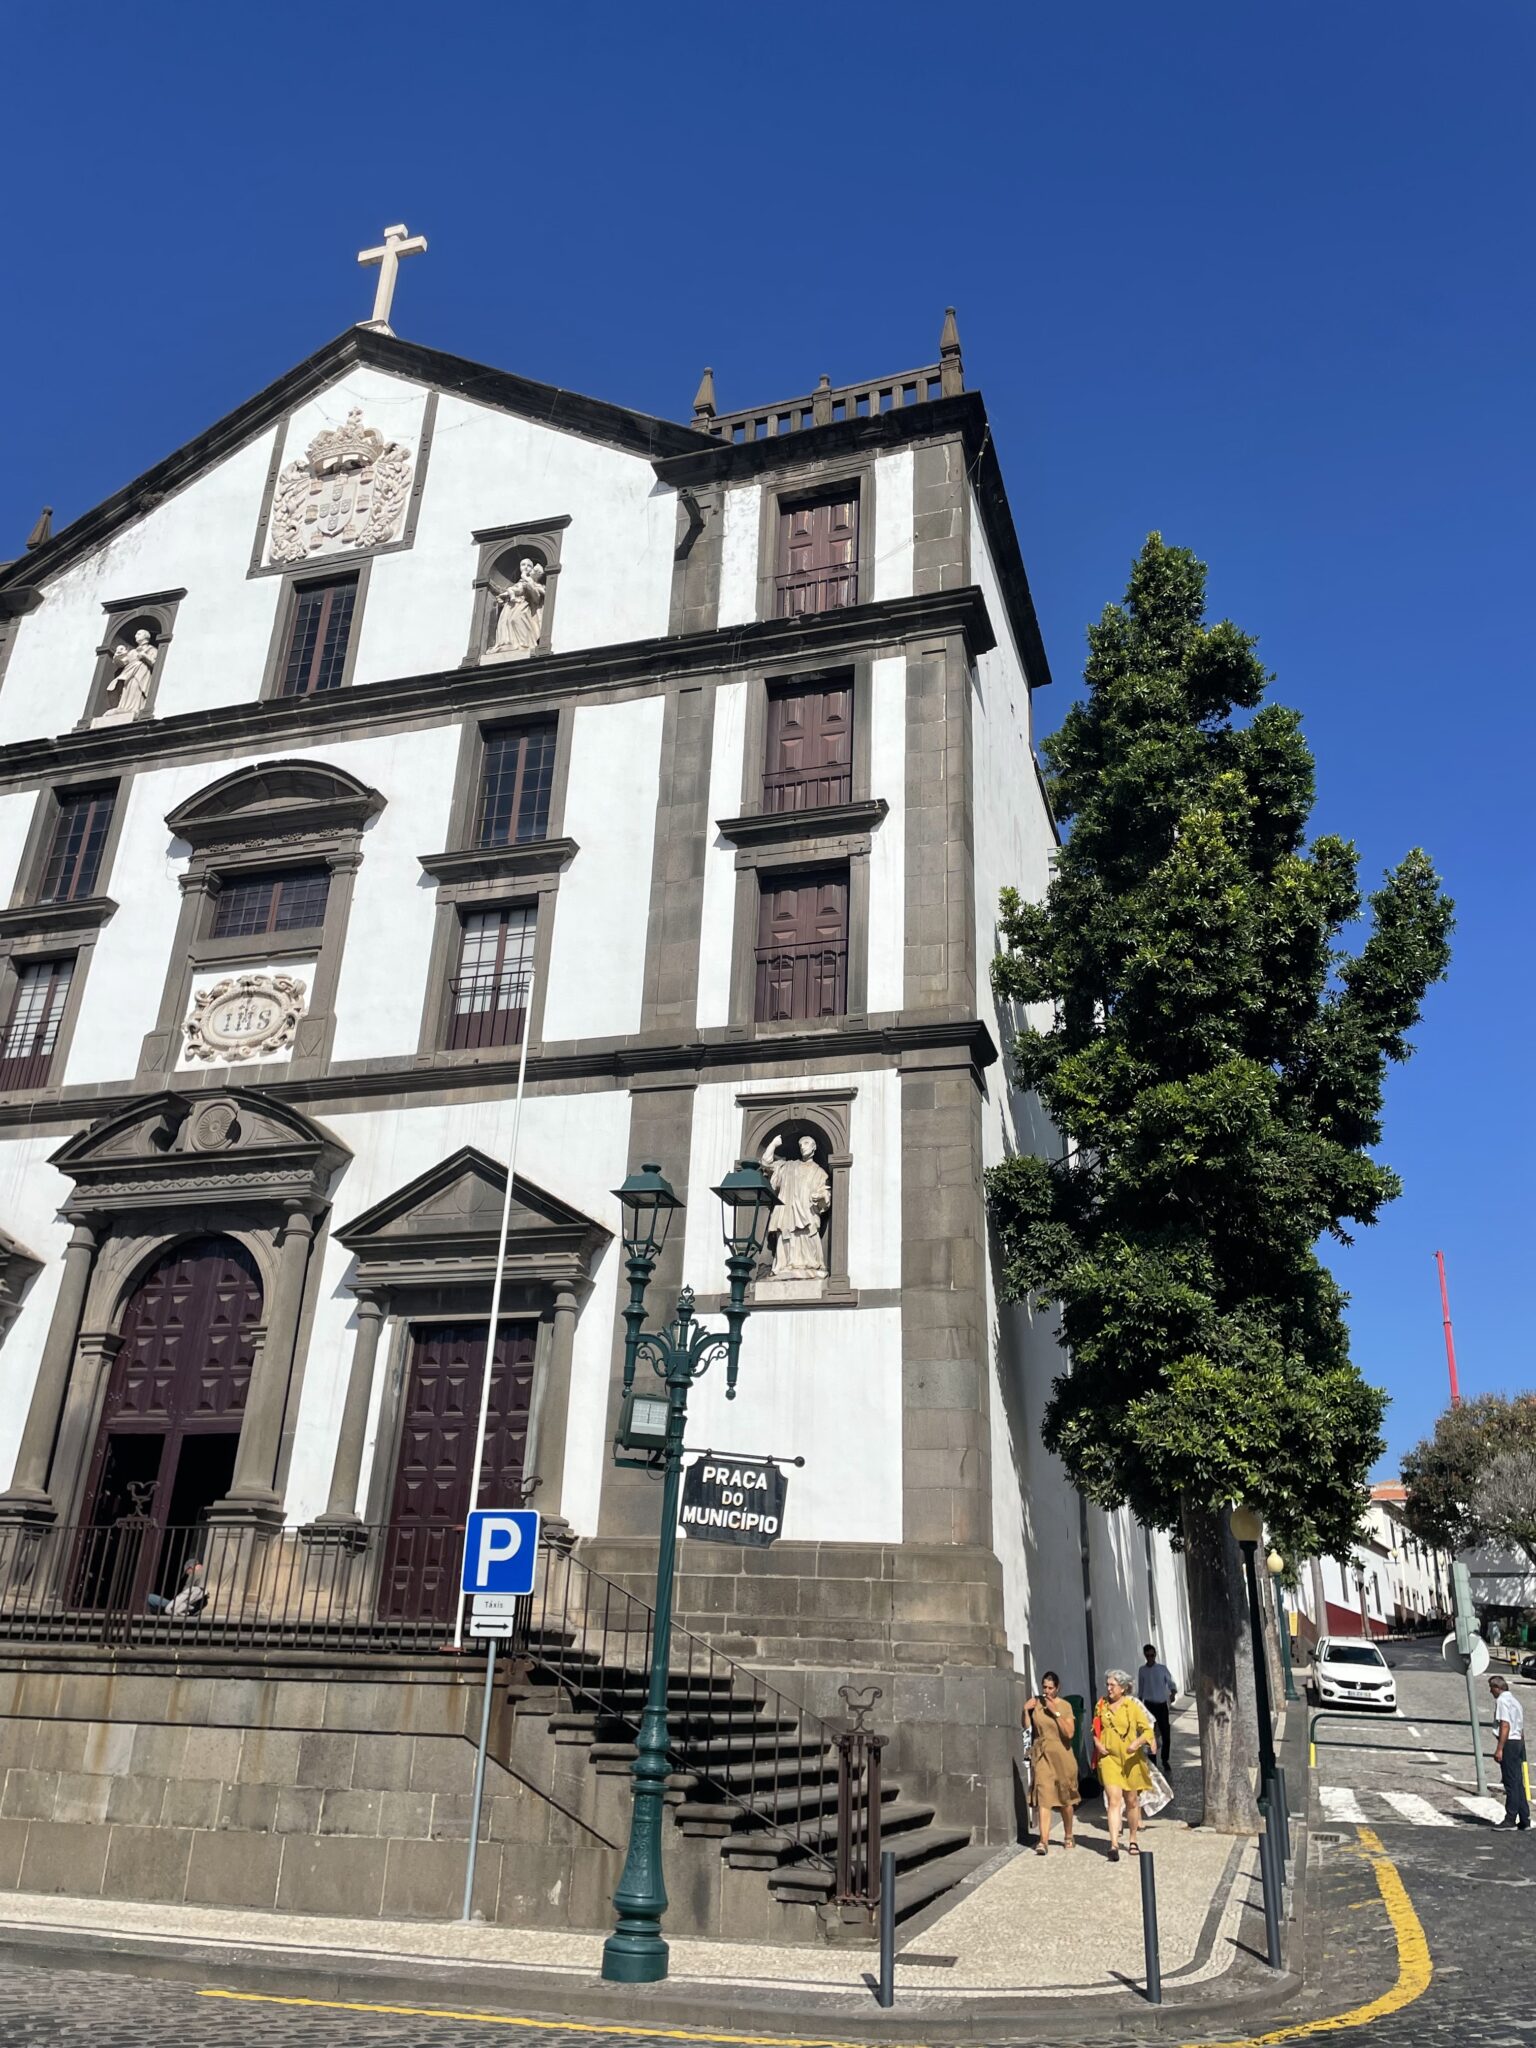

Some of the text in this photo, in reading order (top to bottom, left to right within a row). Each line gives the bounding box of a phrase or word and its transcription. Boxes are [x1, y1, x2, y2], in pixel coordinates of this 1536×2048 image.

[223, 1009, 271, 1032] IHS
[702, 1465, 768, 1490] PRAÇA
[721, 1490, 744, 1507] DO
[682, 1505, 778, 1534] MUNICÍPIO
[476, 1517, 522, 1587] P
[485, 1600, 504, 1609] Táxis
